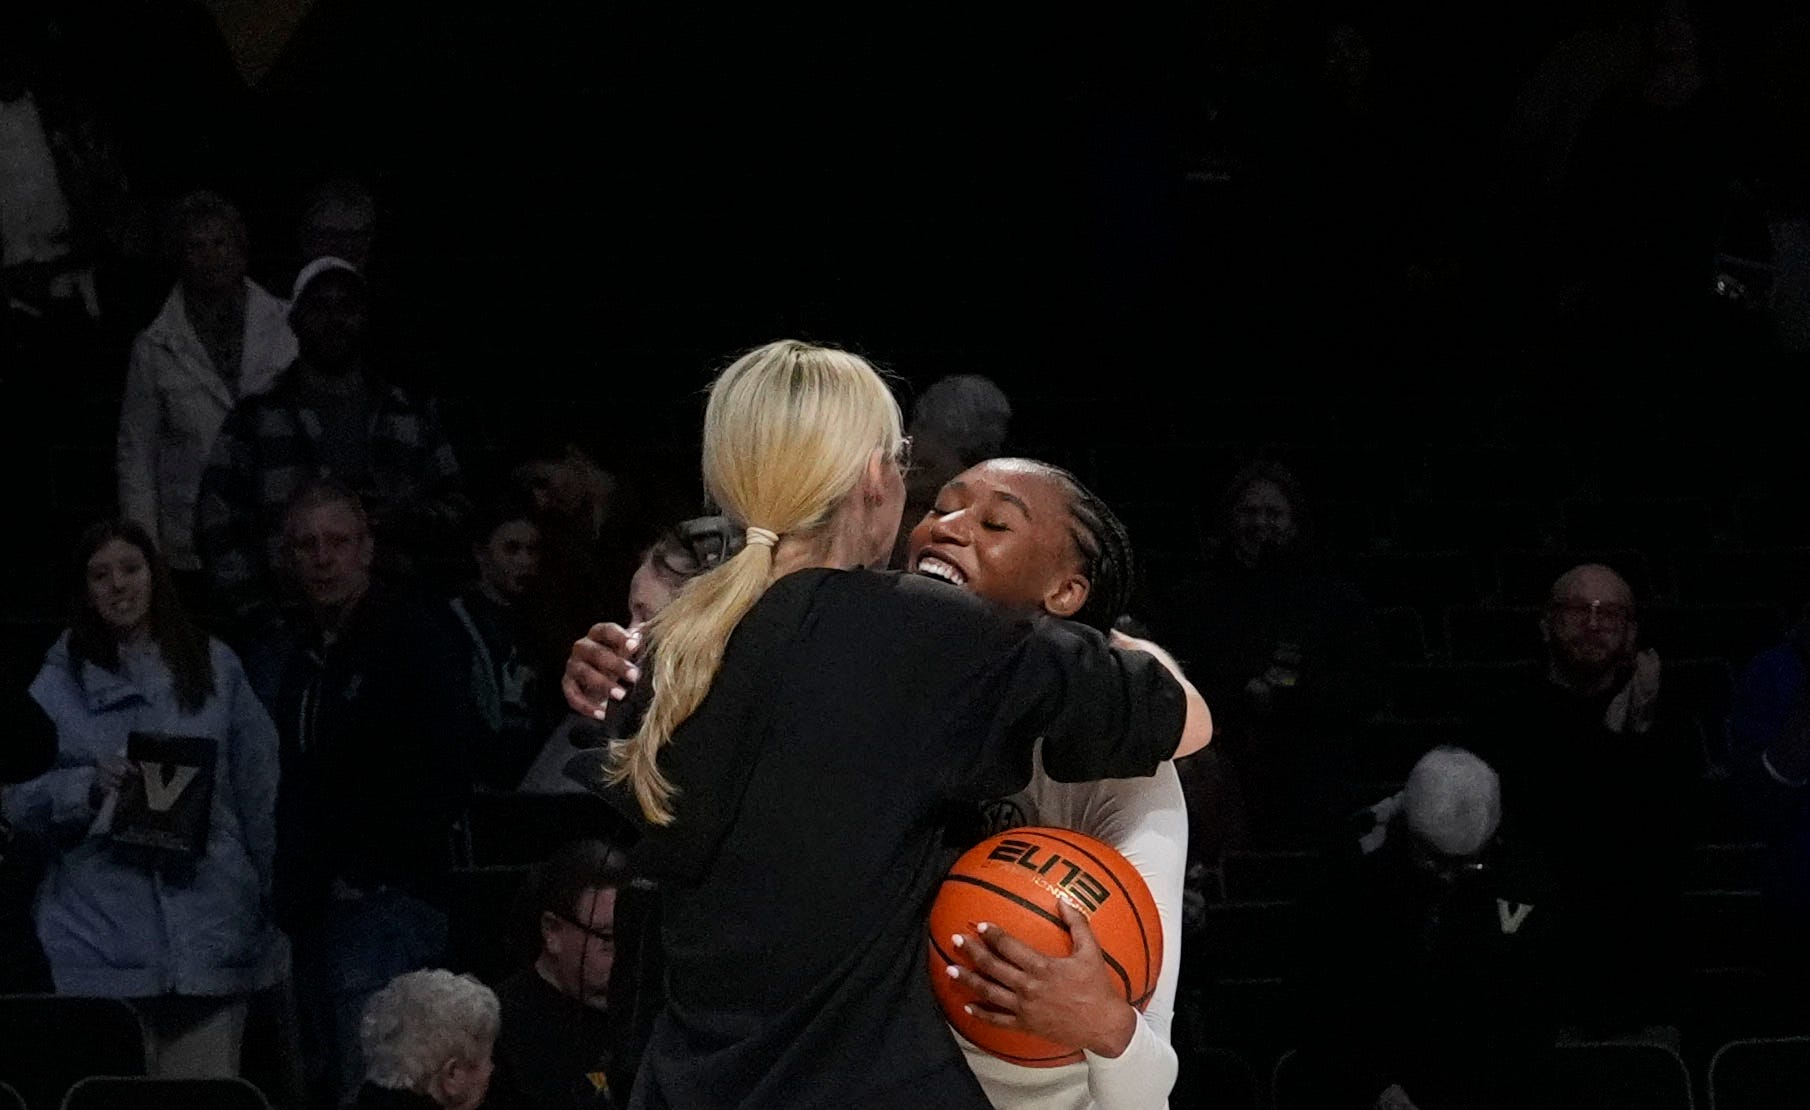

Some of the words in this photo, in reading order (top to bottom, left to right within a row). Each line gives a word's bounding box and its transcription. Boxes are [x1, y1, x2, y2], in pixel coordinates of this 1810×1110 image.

[142, 761, 202, 812] V
[987, 840, 1112, 912] ELITE
[1495, 896, 1536, 934] V
